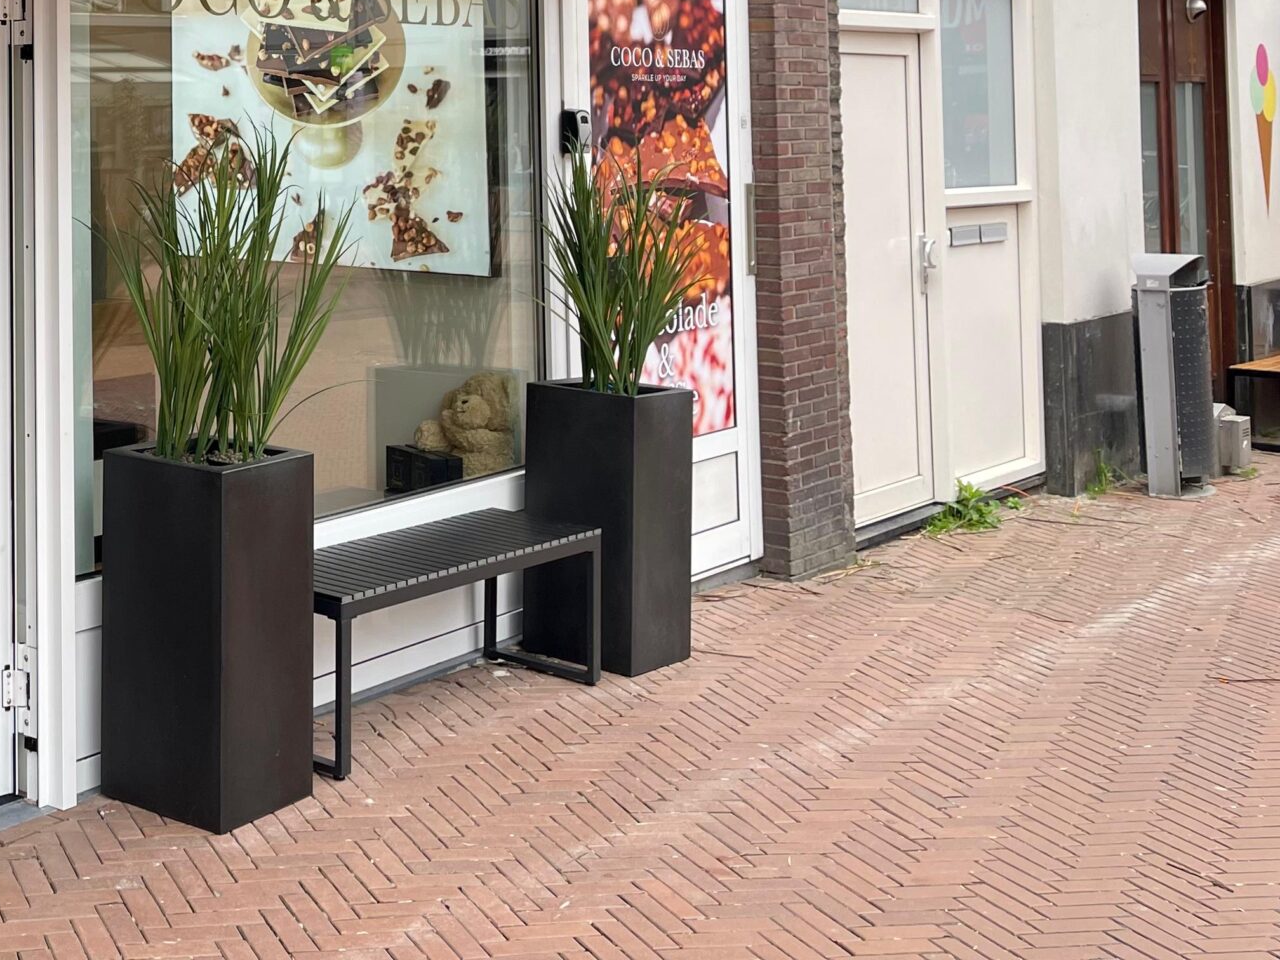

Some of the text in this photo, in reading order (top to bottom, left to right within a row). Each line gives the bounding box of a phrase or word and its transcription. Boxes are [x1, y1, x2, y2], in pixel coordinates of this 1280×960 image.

[610, 46, 706, 69] COCO & SEBAS
[631, 73, 654, 82] SPARKLE
[677, 74, 687, 82] DAY
[658, 289, 719, 335] olade
[658, 342, 677, 378] &
